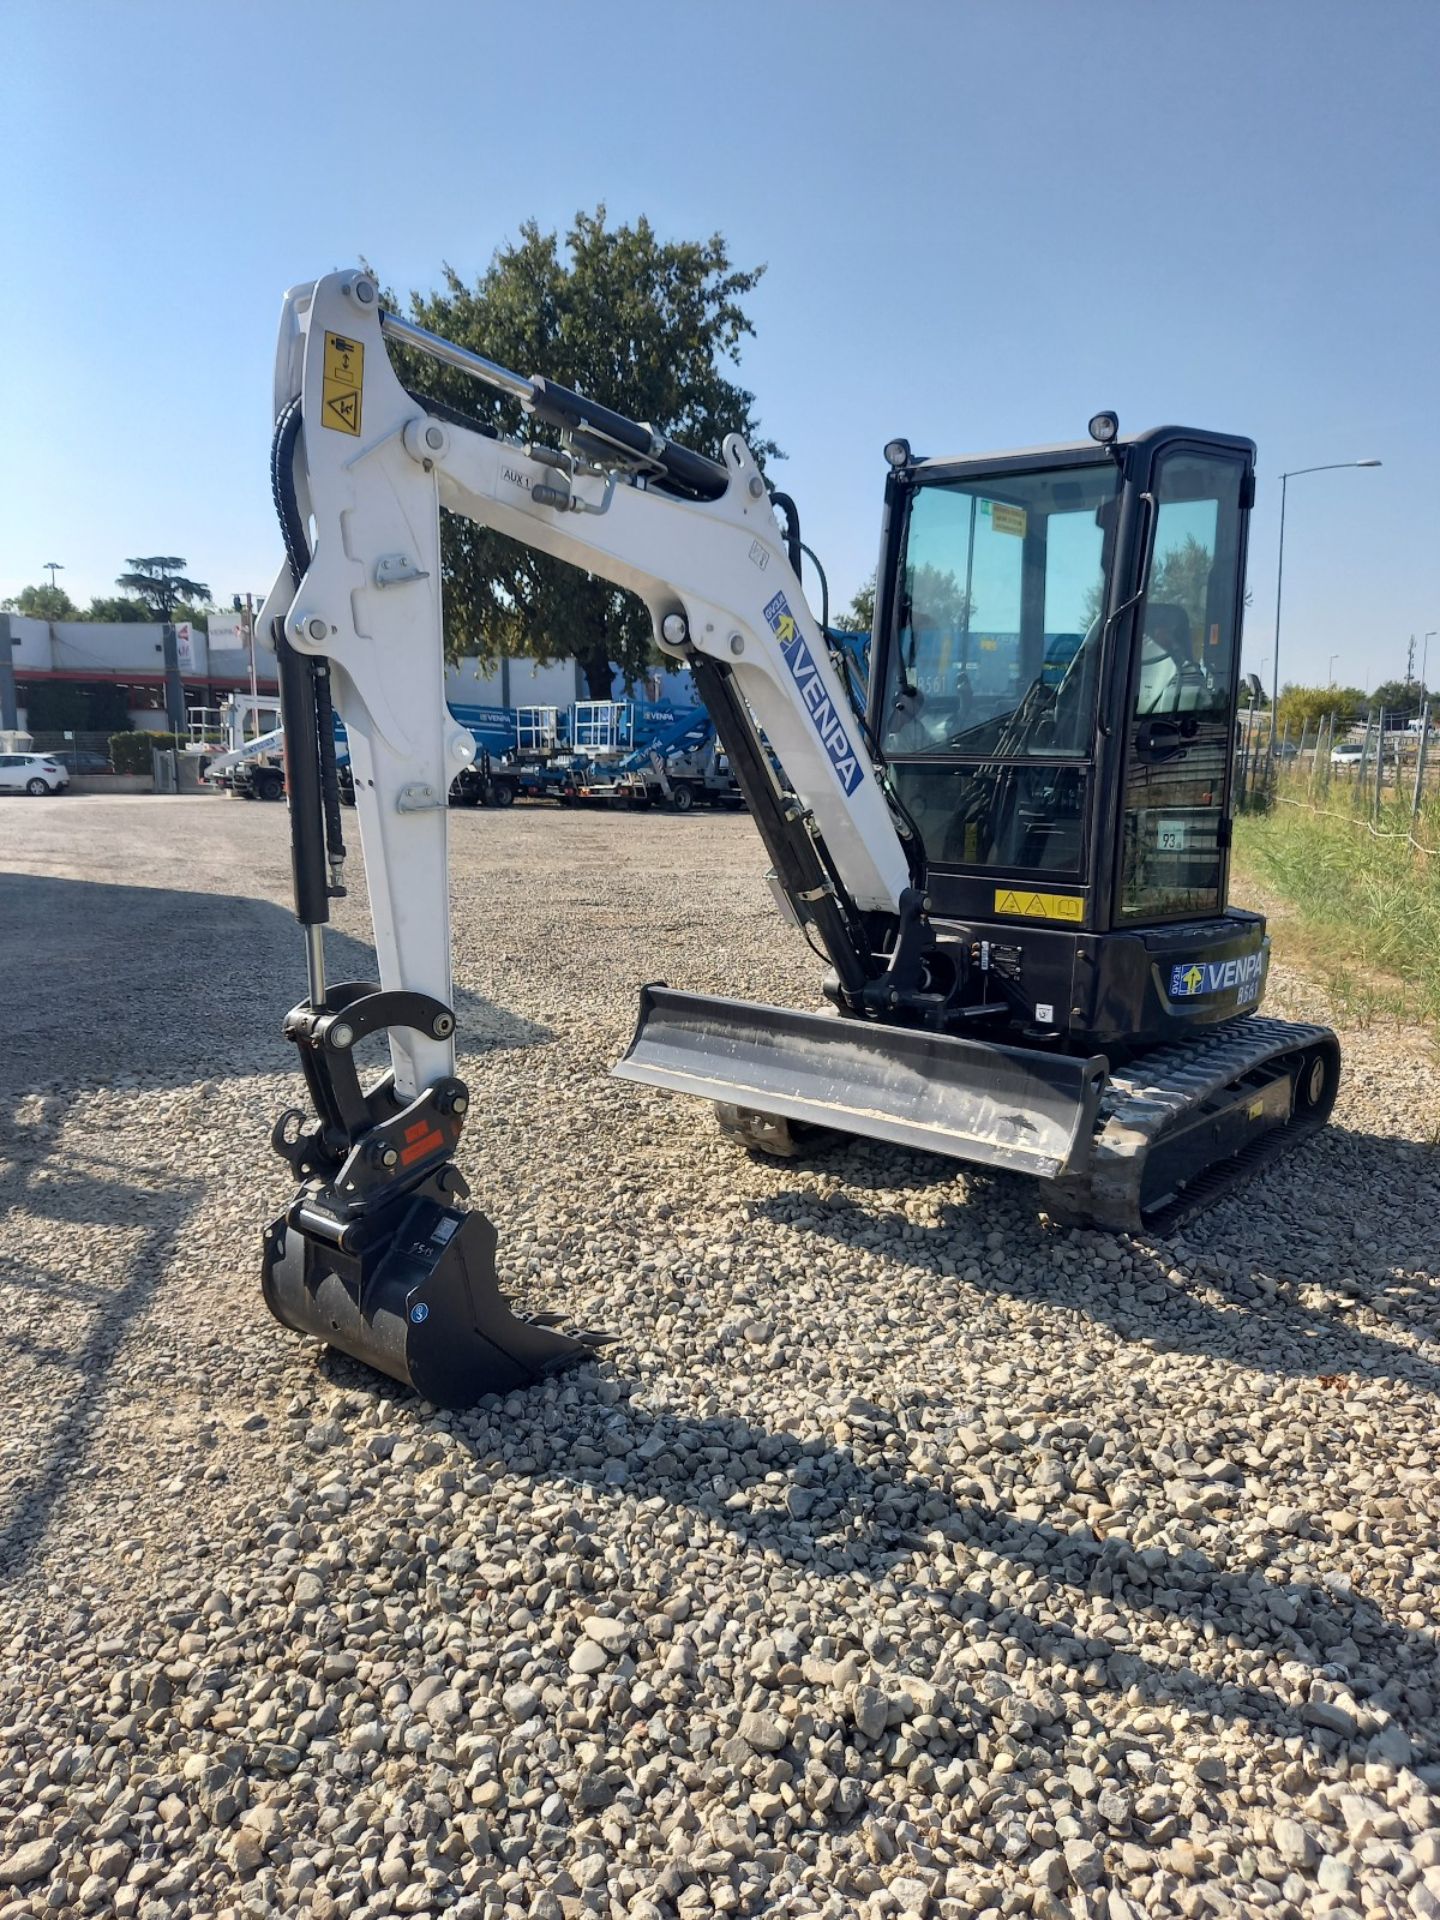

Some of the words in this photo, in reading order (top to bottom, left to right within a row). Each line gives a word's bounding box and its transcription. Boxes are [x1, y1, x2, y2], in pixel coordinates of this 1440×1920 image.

[503, 469, 523, 486] AUX
[792, 643, 858, 790] VENPA
[1163, 833, 1176, 848] 93
[1208, 951, 1263, 991] VENPA
[1236, 981, 1260, 1006] 8561
